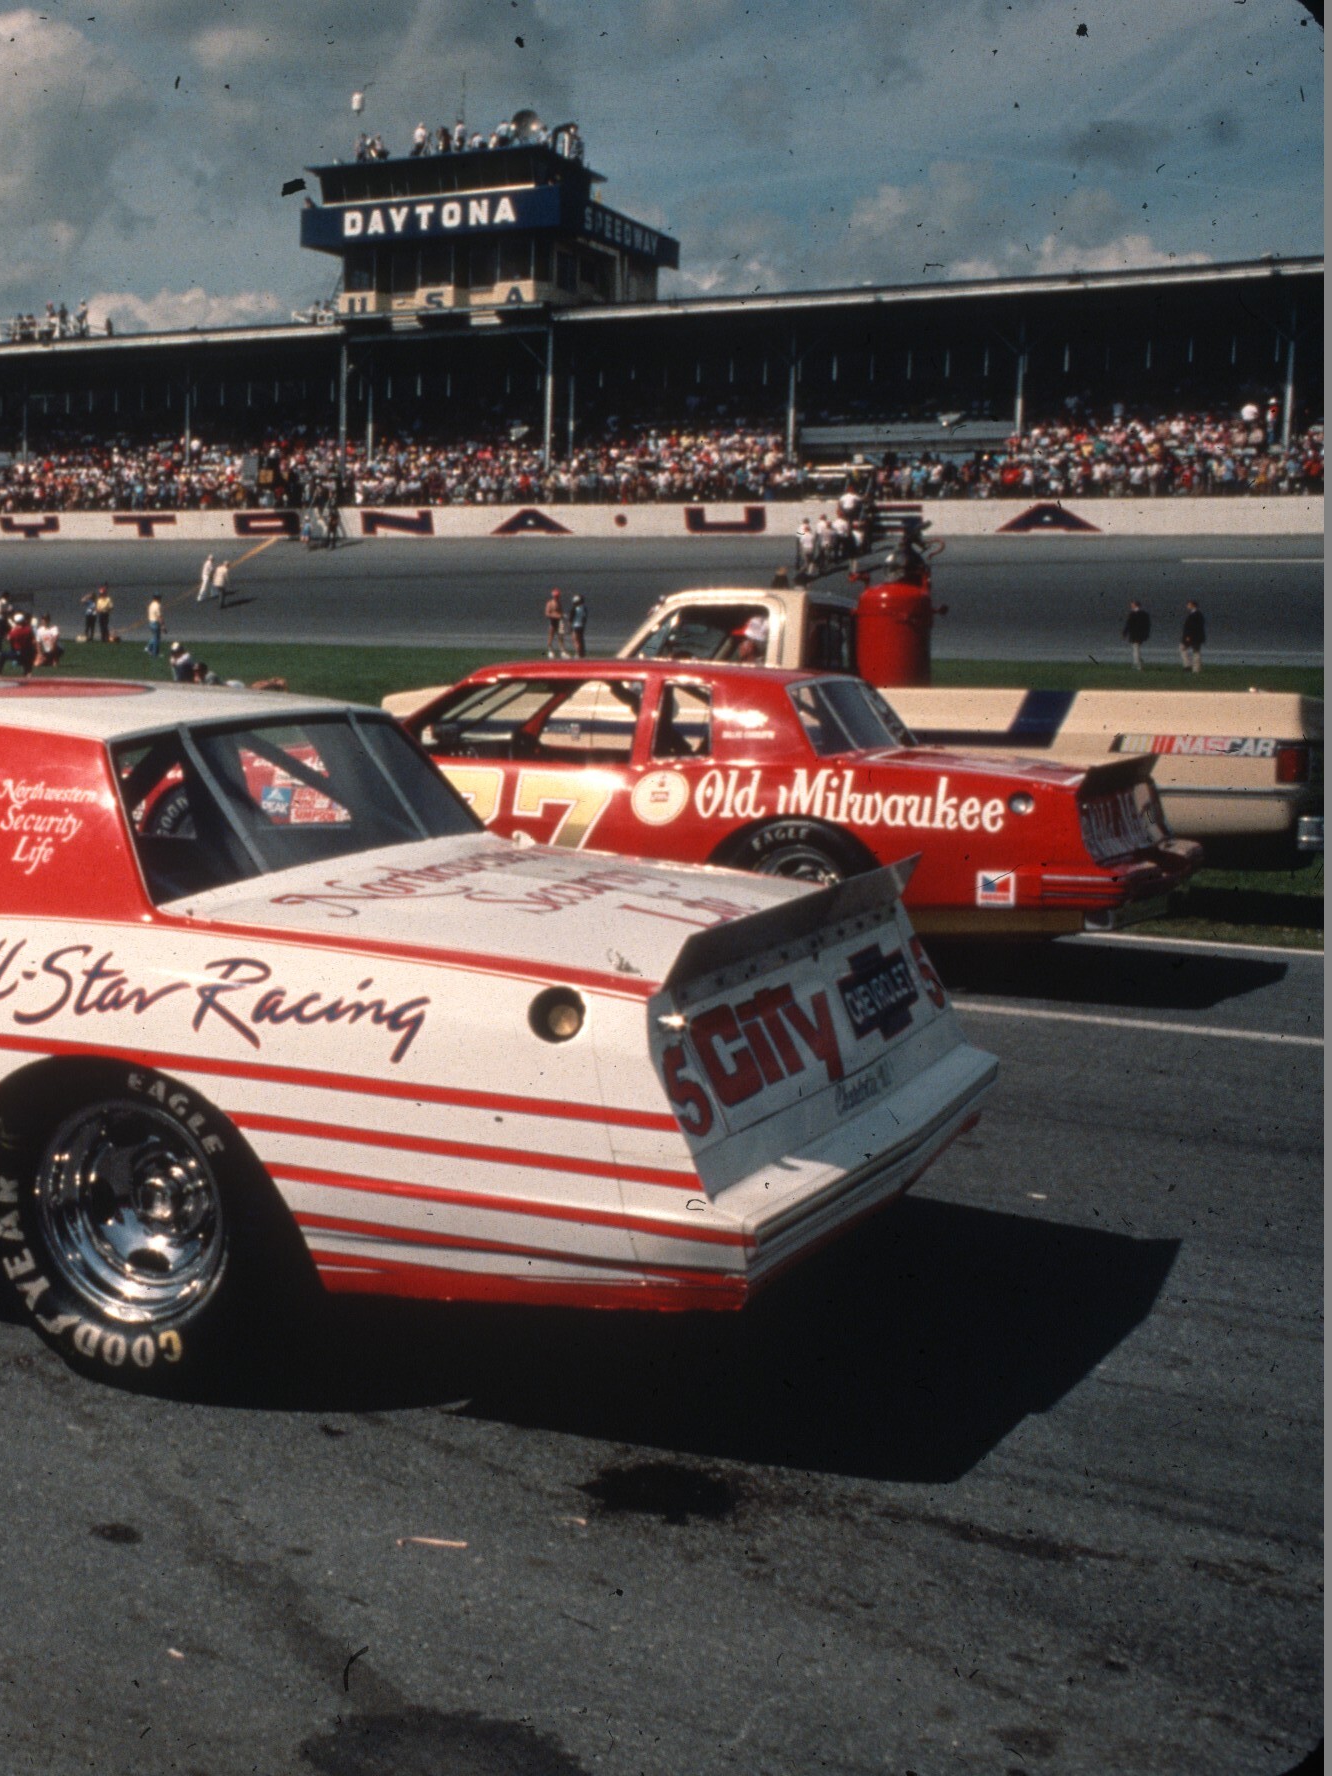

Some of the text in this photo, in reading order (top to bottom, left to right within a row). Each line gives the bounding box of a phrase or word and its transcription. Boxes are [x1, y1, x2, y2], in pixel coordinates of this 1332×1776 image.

[344, 196, 517, 237] DAYTONA
[584, 206, 659, 256] SPEEDWAY
[1170, 735, 1276, 757] NASCAR
[0, 804, 82, 842] Security
[695, 768, 1005, 833] Old Milwaukee
[12, 836, 54, 875] Life
[752, 827, 808, 851] EAGLE
[192, 957, 431, 1064] Racing
[844, 961, 916, 1025] CHEVROLET
[127, 1072, 225, 1154] EAGLE
